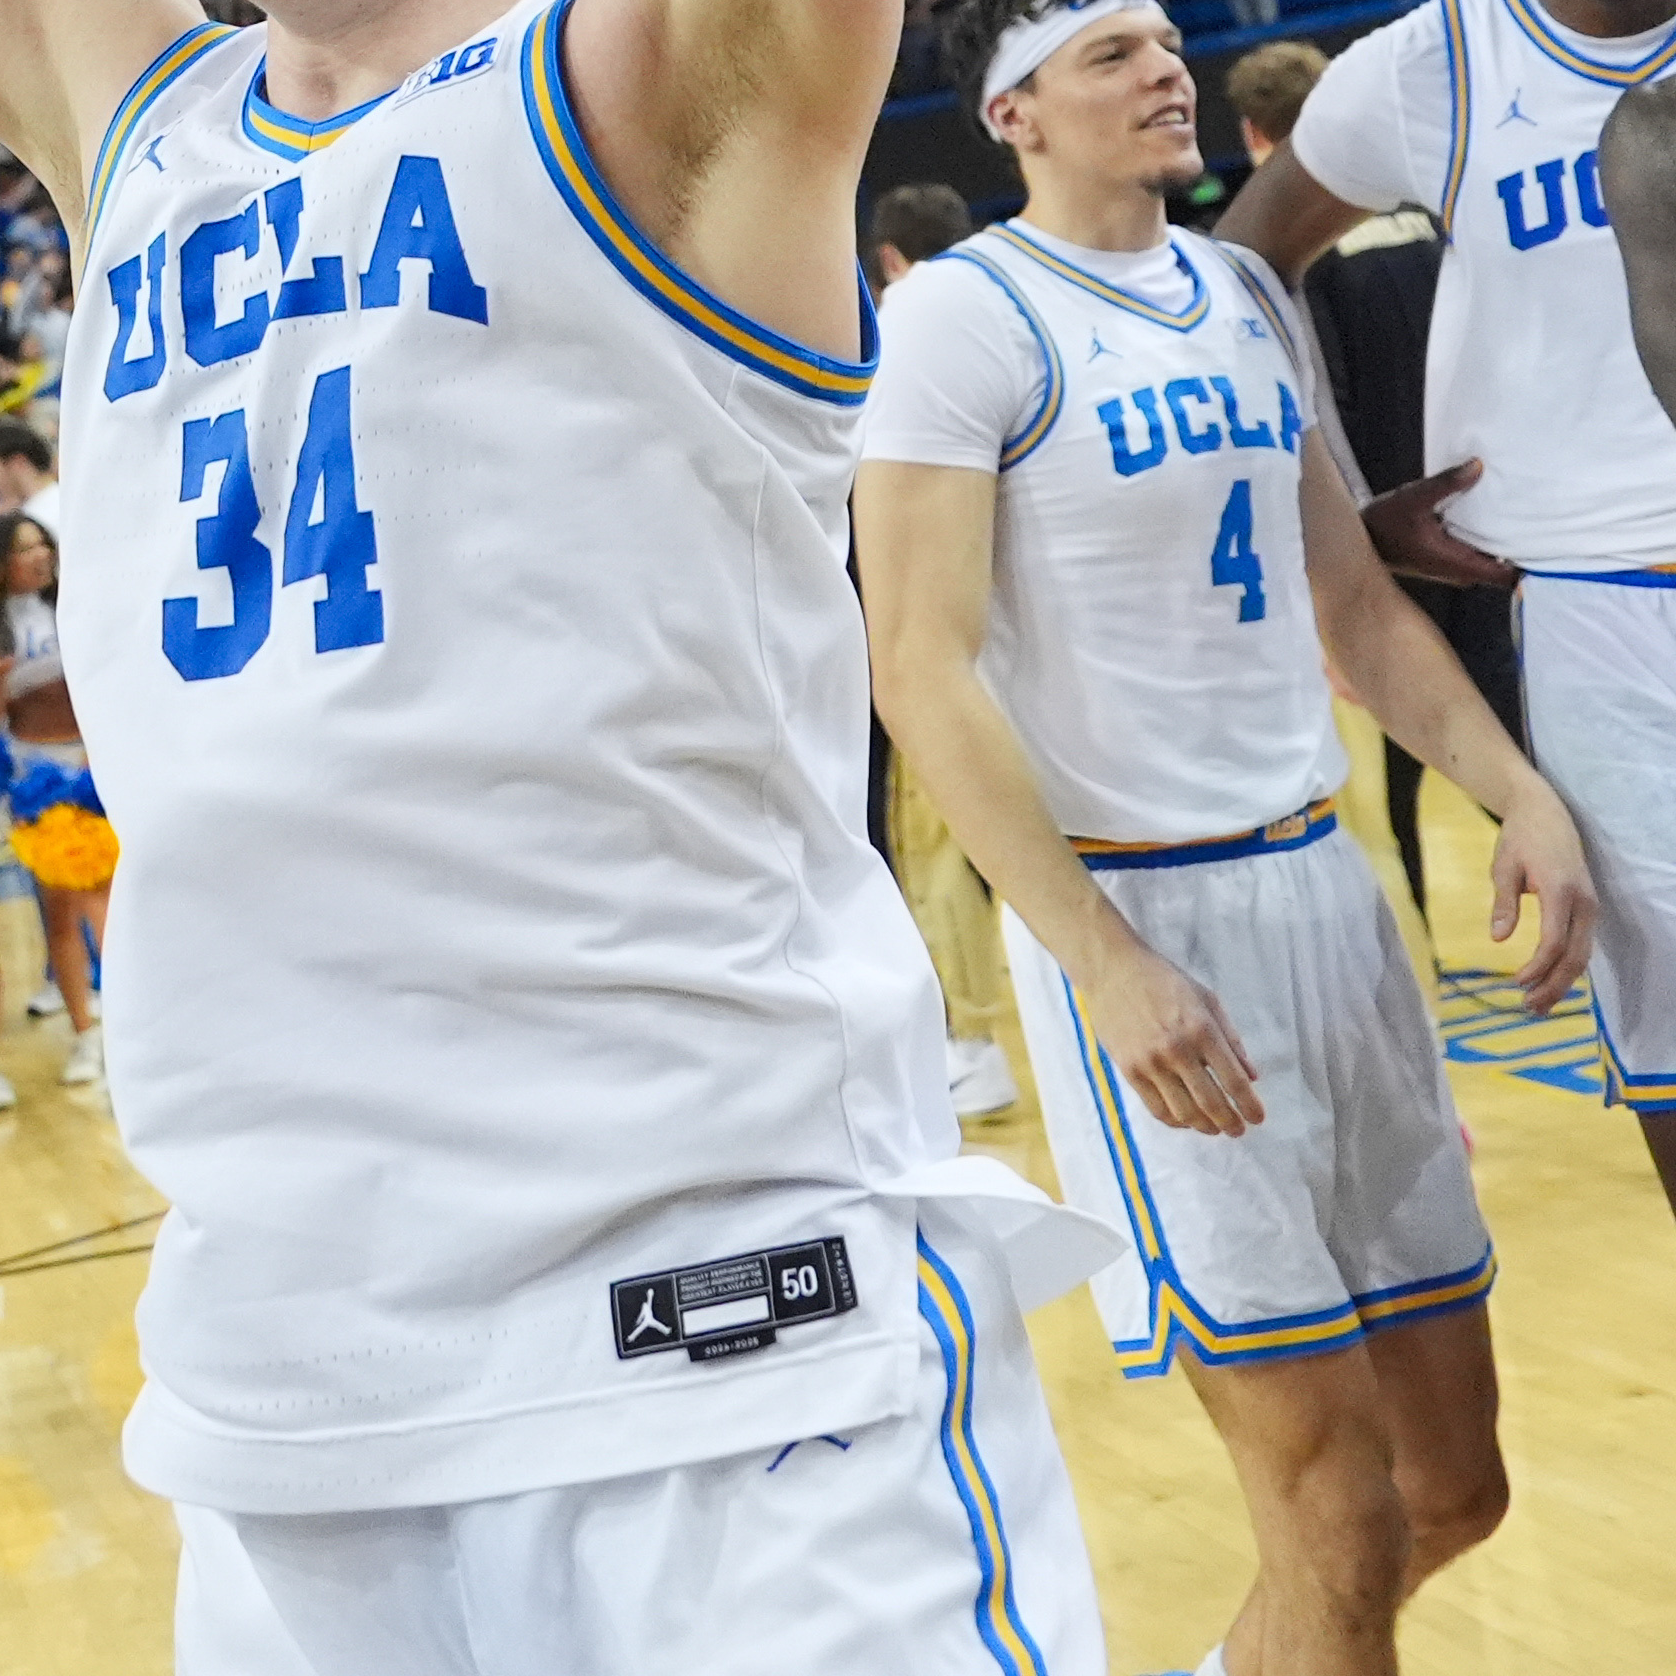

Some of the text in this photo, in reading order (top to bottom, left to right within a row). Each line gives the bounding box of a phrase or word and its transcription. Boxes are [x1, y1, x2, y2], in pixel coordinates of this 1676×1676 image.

[1497, 149, 1611, 251] UC
[103, 154, 489, 403] UCLA
[162, 364, 385, 682] 34
[1211, 478, 1267, 623] 4
[781, 1265, 818, 1301] 50
